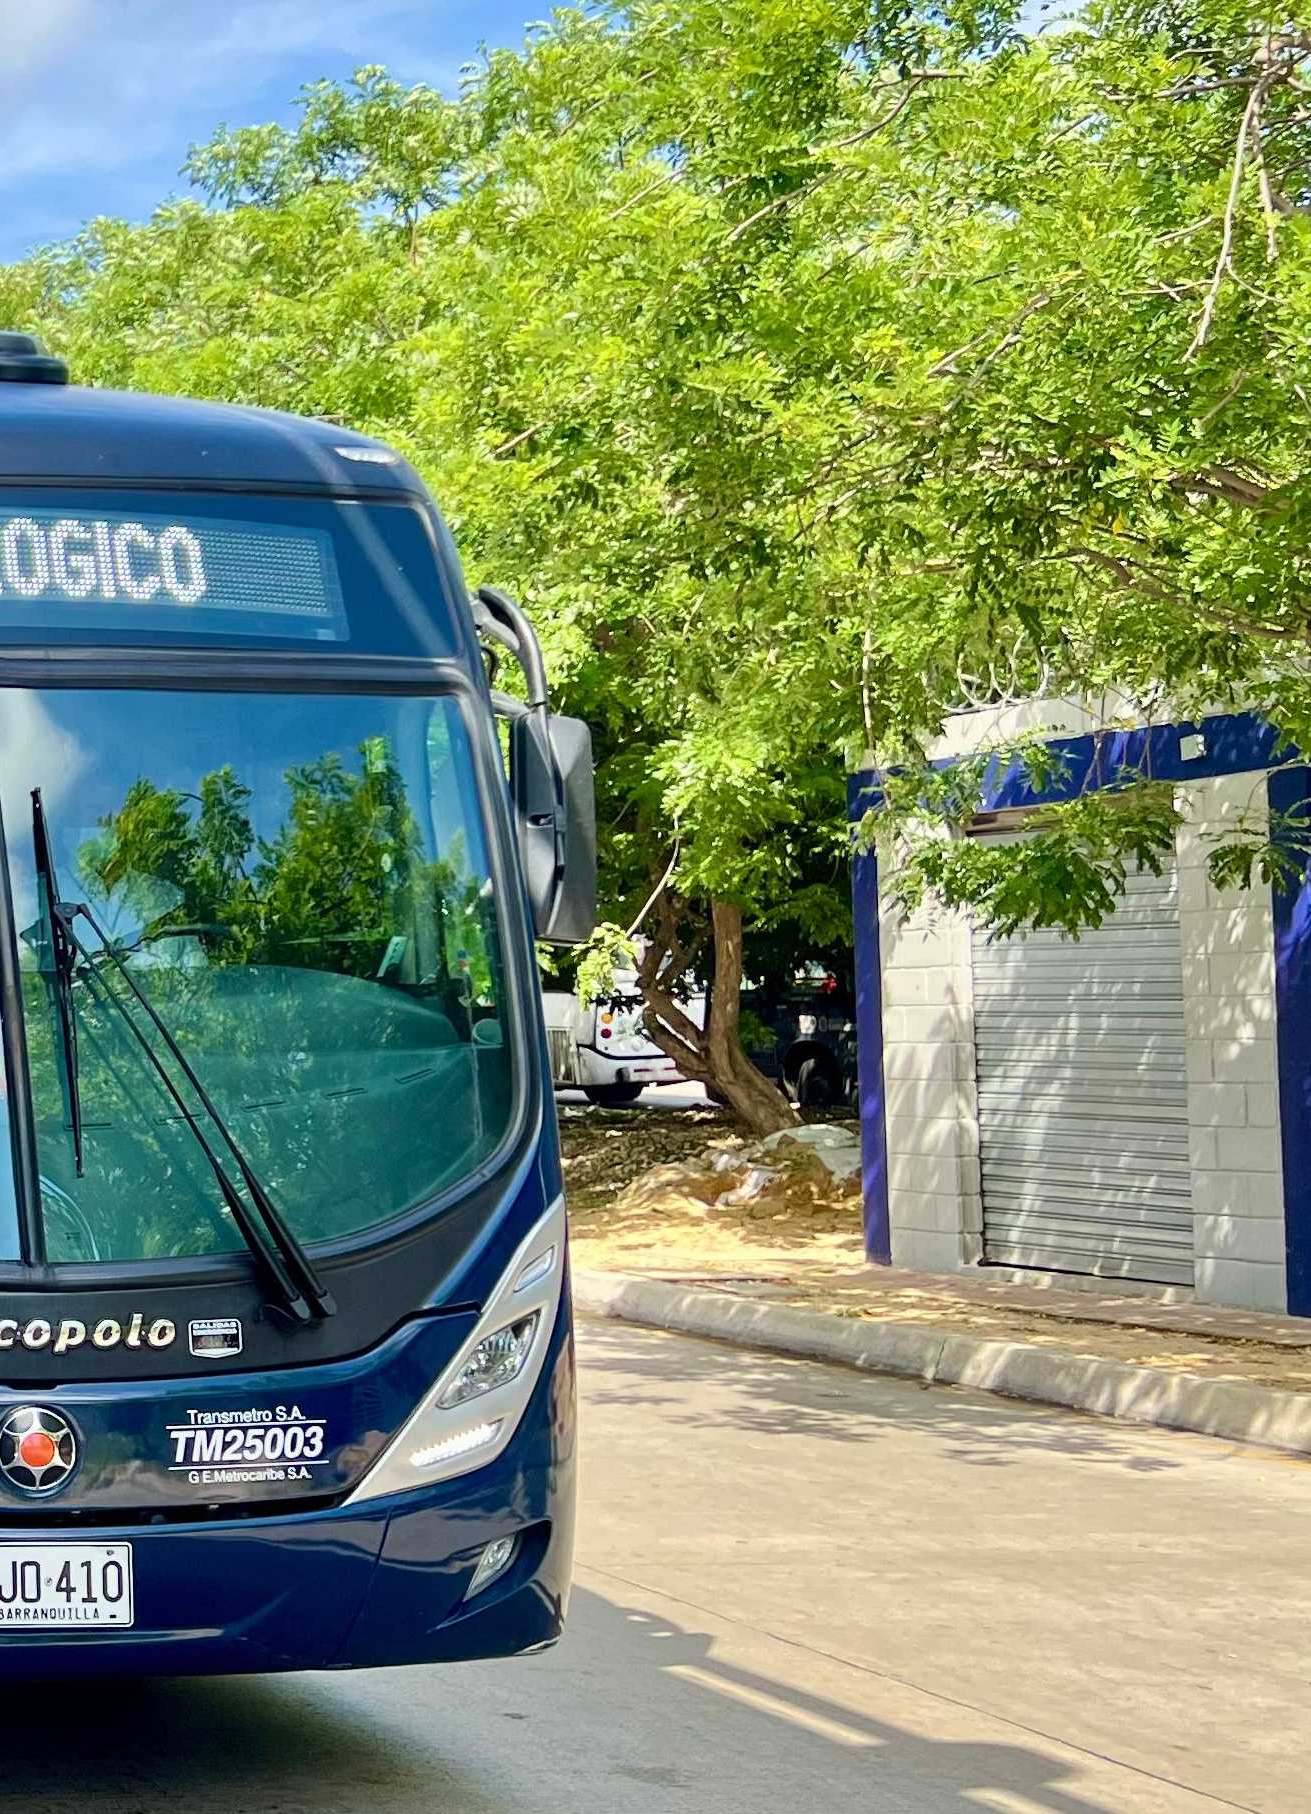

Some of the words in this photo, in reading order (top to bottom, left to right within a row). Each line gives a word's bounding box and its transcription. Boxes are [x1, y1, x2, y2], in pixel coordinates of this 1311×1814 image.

[187, 1408, 273, 1425] Transmetro
[275, 1405, 307, 1422] S.A.
[170, 1425, 325, 1464] TM25003
[287, 1466, 314, 1480] S.A.
[55, 1560, 124, 1604] 410
